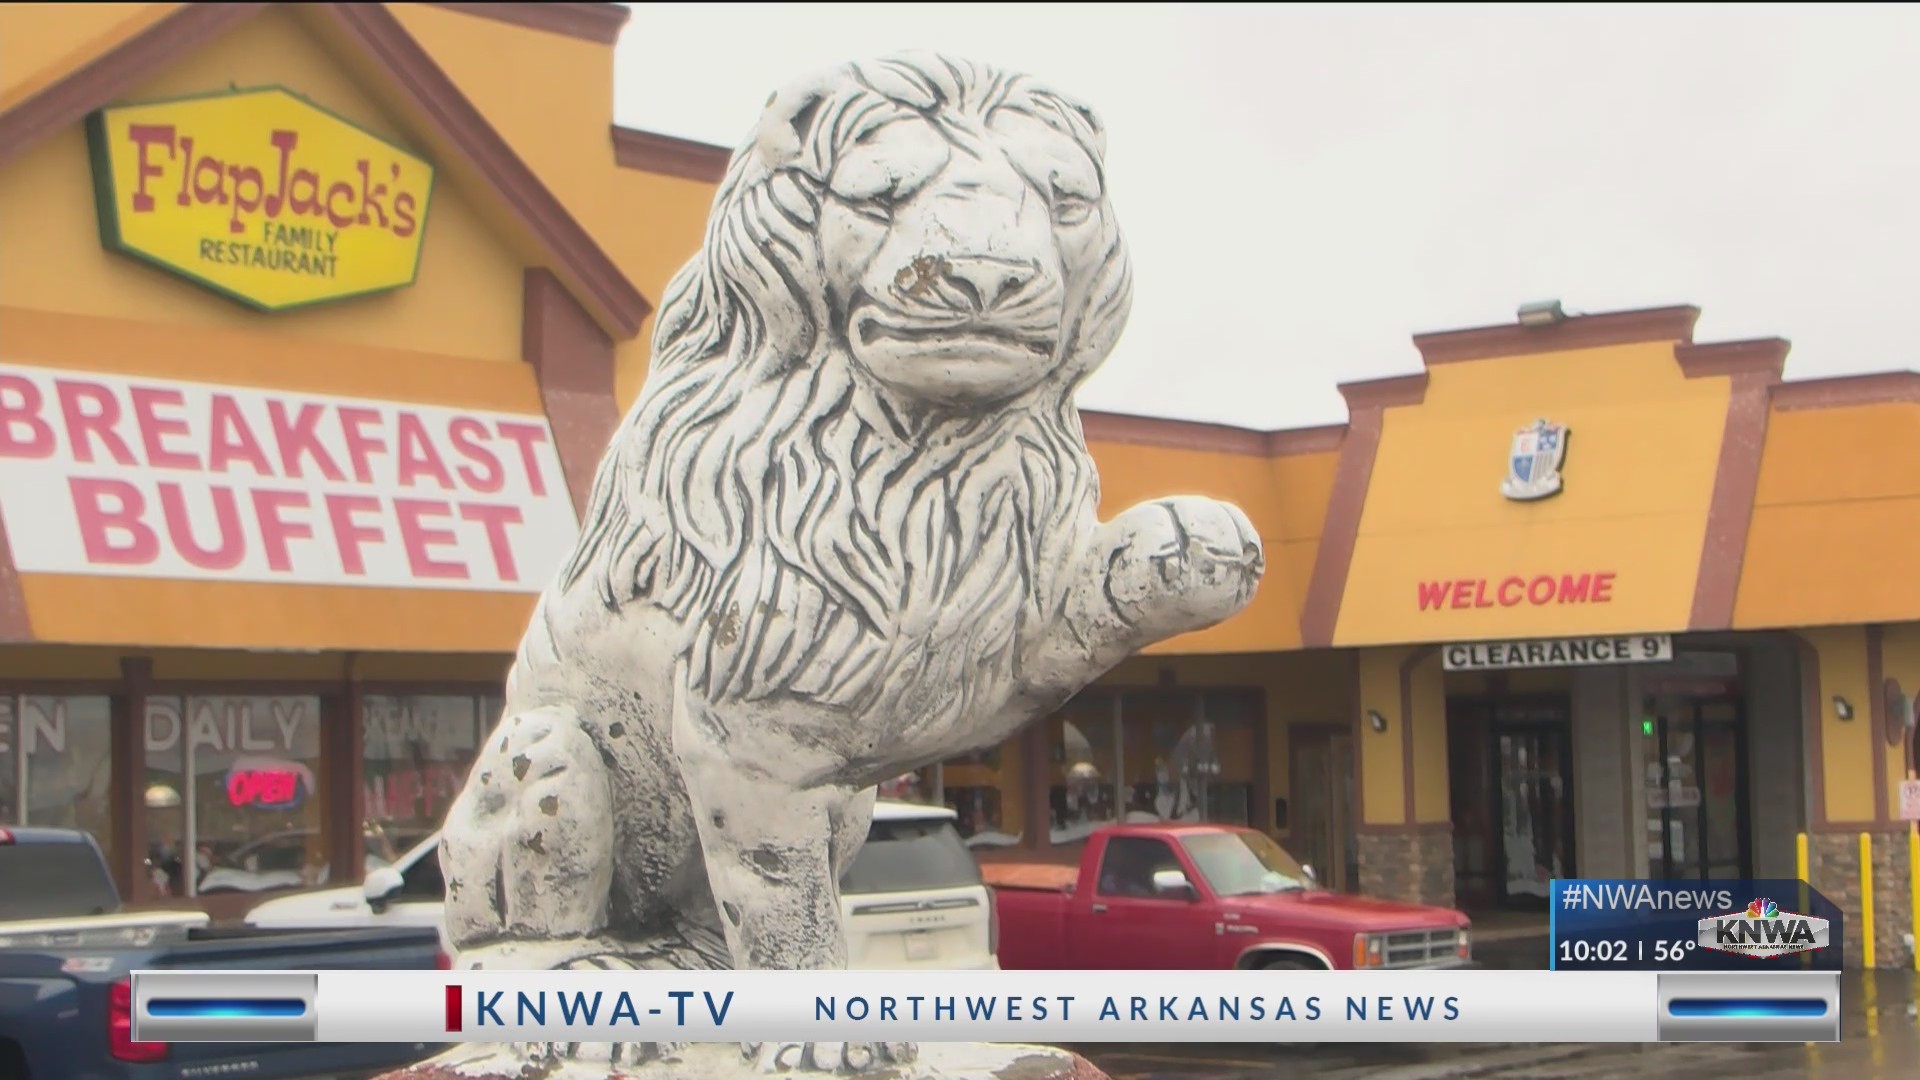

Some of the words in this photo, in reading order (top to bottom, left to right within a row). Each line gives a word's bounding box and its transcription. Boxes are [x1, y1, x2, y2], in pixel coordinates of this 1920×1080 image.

[129, 123, 416, 238] FlapJack's
[264, 221, 338, 252] FAMILY
[200, 237, 337, 278] RESTAURANT
[0, 374, 548, 498] BREAKFAST
[67, 476, 524, 583] BUFFET
[1417, 572, 1617, 611] WELCOME
[1447, 639, 1632, 668] CLEARANCE
[144, 703, 303, 752] DAILY
[229, 769, 298, 807] OPEN
